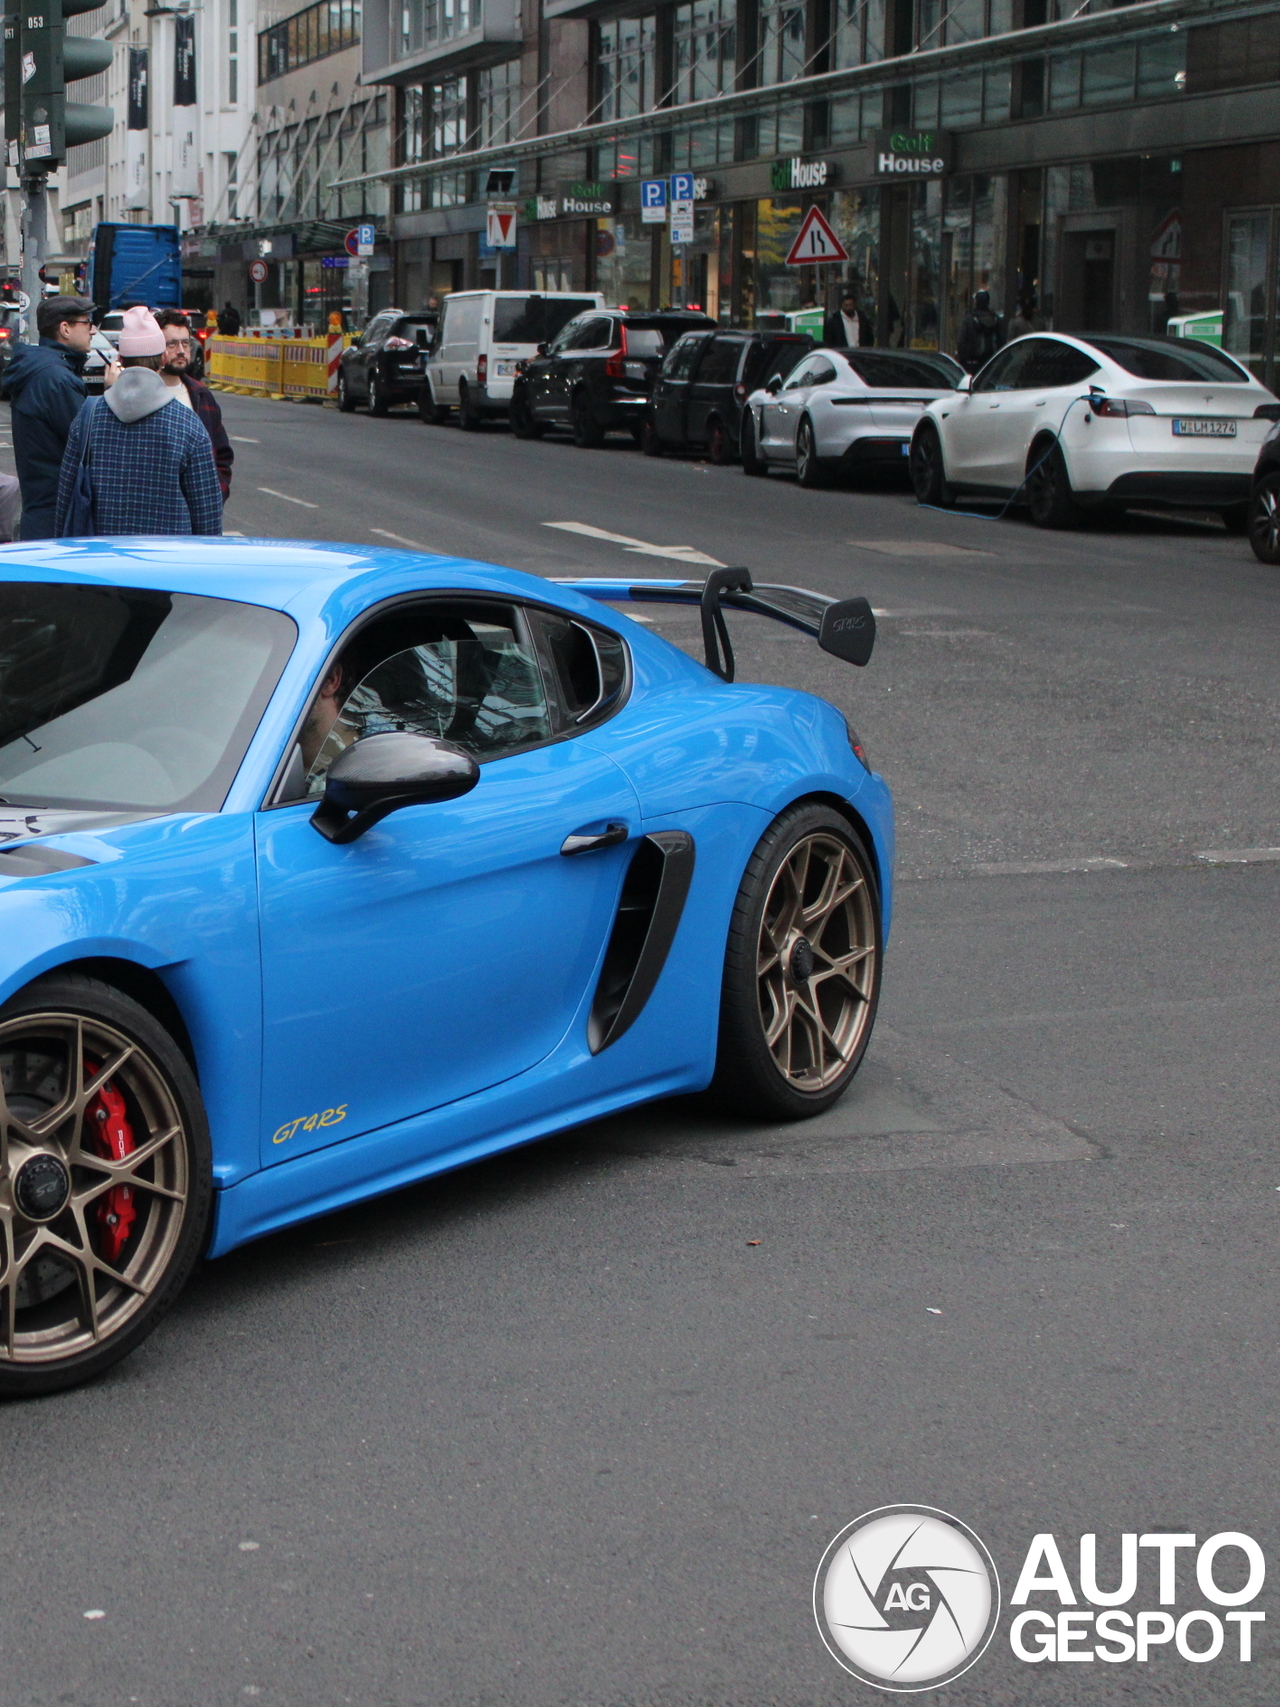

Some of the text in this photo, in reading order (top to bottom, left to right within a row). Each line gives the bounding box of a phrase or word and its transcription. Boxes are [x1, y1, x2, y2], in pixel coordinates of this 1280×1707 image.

[28, 16, 44, 28] 053
[890, 132, 934, 152] Golf
[878, 152, 945, 173] House
[571, 183, 603, 197] Golf
[562, 198, 612, 213] House
[1180, 422, 1187, 432] W
